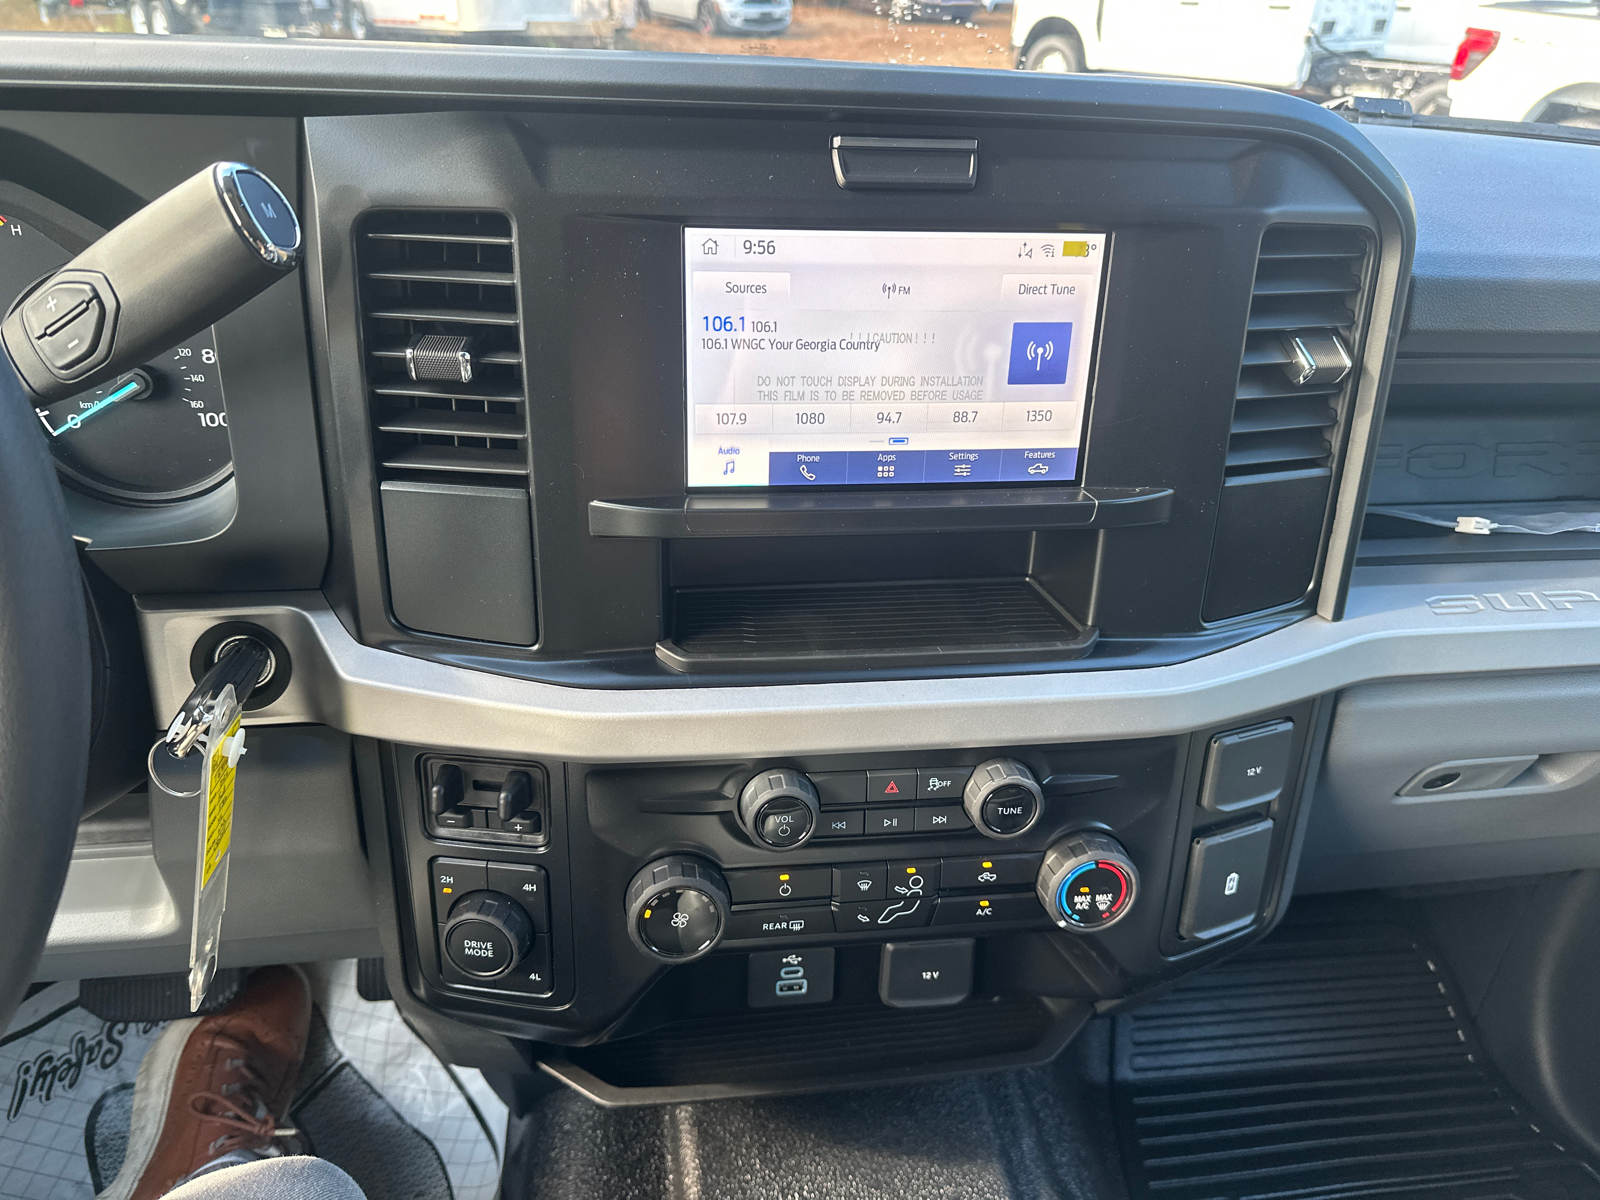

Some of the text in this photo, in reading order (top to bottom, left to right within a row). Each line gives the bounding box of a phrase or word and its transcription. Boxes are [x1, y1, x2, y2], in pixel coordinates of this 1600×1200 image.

[260, 202, 277, 219] M
[10, 224, 22, 236] H
[743, 239, 776, 255] 9:56
[725, 281, 767, 294] Sources
[898, 286, 911, 295] FM
[1018, 283, 1076, 295] Direct Tune
[702, 315, 778, 333] 106.1 106.1
[701, 338, 881, 352] 106.1 WNGC Your Georgia Country
[178, 348, 192, 357] 120
[201, 348, 216, 364] 8
[190, 374, 205, 383] 140
[757, 375, 984, 387] DO NOT TOUCH DISPLAY DURING INSTALLATION
[757, 390, 984, 402] THIS FILM IS TO BE REMOVED BEFORE USAGE
[190, 400, 205, 409] 160
[716, 412, 748, 426] 107.9
[796, 412, 826, 425] 1080
[876, 411, 903, 424] 94.7
[953, 410, 979, 423] 88.7
[1026, 409, 1053, 422] 1350
[67, 414, 82, 429] 0
[718, 446, 741, 455] Audio
[1024, 450, 1056, 460] Features
[796, 454, 821, 463] Phone
[877, 453, 897, 462] Apps
[949, 451, 979, 461] Settings
[937, 780, 952, 788] OFF
[997, 806, 1024, 815] TUNE
[774, 815, 795, 824] VOL
[440, 875, 454, 885] 2H
[522, 883, 537, 892] 4H
[1073, 894, 1092, 904] MAX
[1095, 893, 1114, 902] MAX
[1075, 901, 1091, 910] A/C
[976, 908, 993, 917] A/C
[762, 921, 788, 931] REAR
[464, 939, 494, 950] DRIVE
[464, 947, 495, 958] MODE
[528, 973, 542, 982] 4L
[7, 1020, 128, 1122] Safely!
